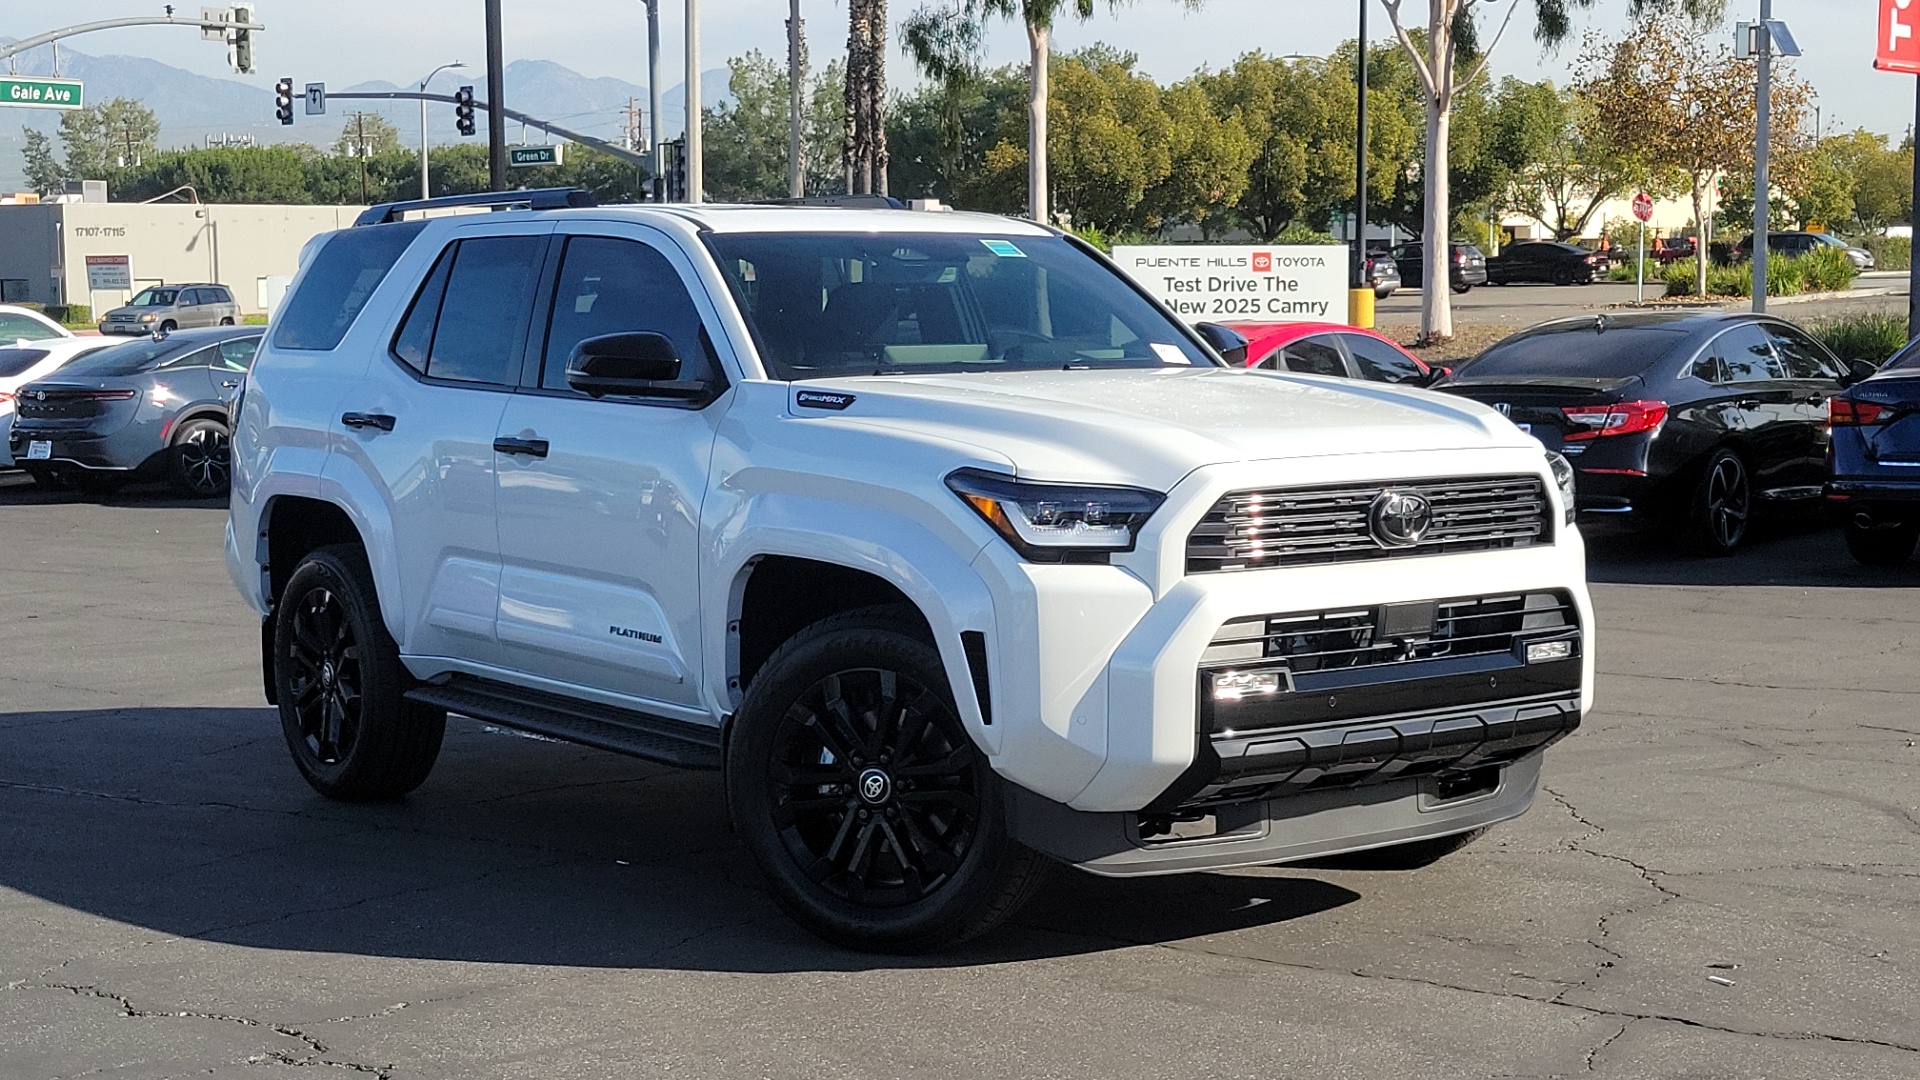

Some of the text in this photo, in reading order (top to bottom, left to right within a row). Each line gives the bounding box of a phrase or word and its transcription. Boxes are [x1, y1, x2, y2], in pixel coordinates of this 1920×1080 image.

[1889, 0, 1912, 51] T
[11, 85, 71, 101] Gale Ave
[517, 151, 549, 161] Green Dr
[1135, 257, 1325, 268] PUENTE HILLS TOYOTA
[1163, 276, 1299, 292] Test Drive The
[1164, 298, 1329, 316] New 2025 Camry
[609, 625, 663, 644] PLATINUM
